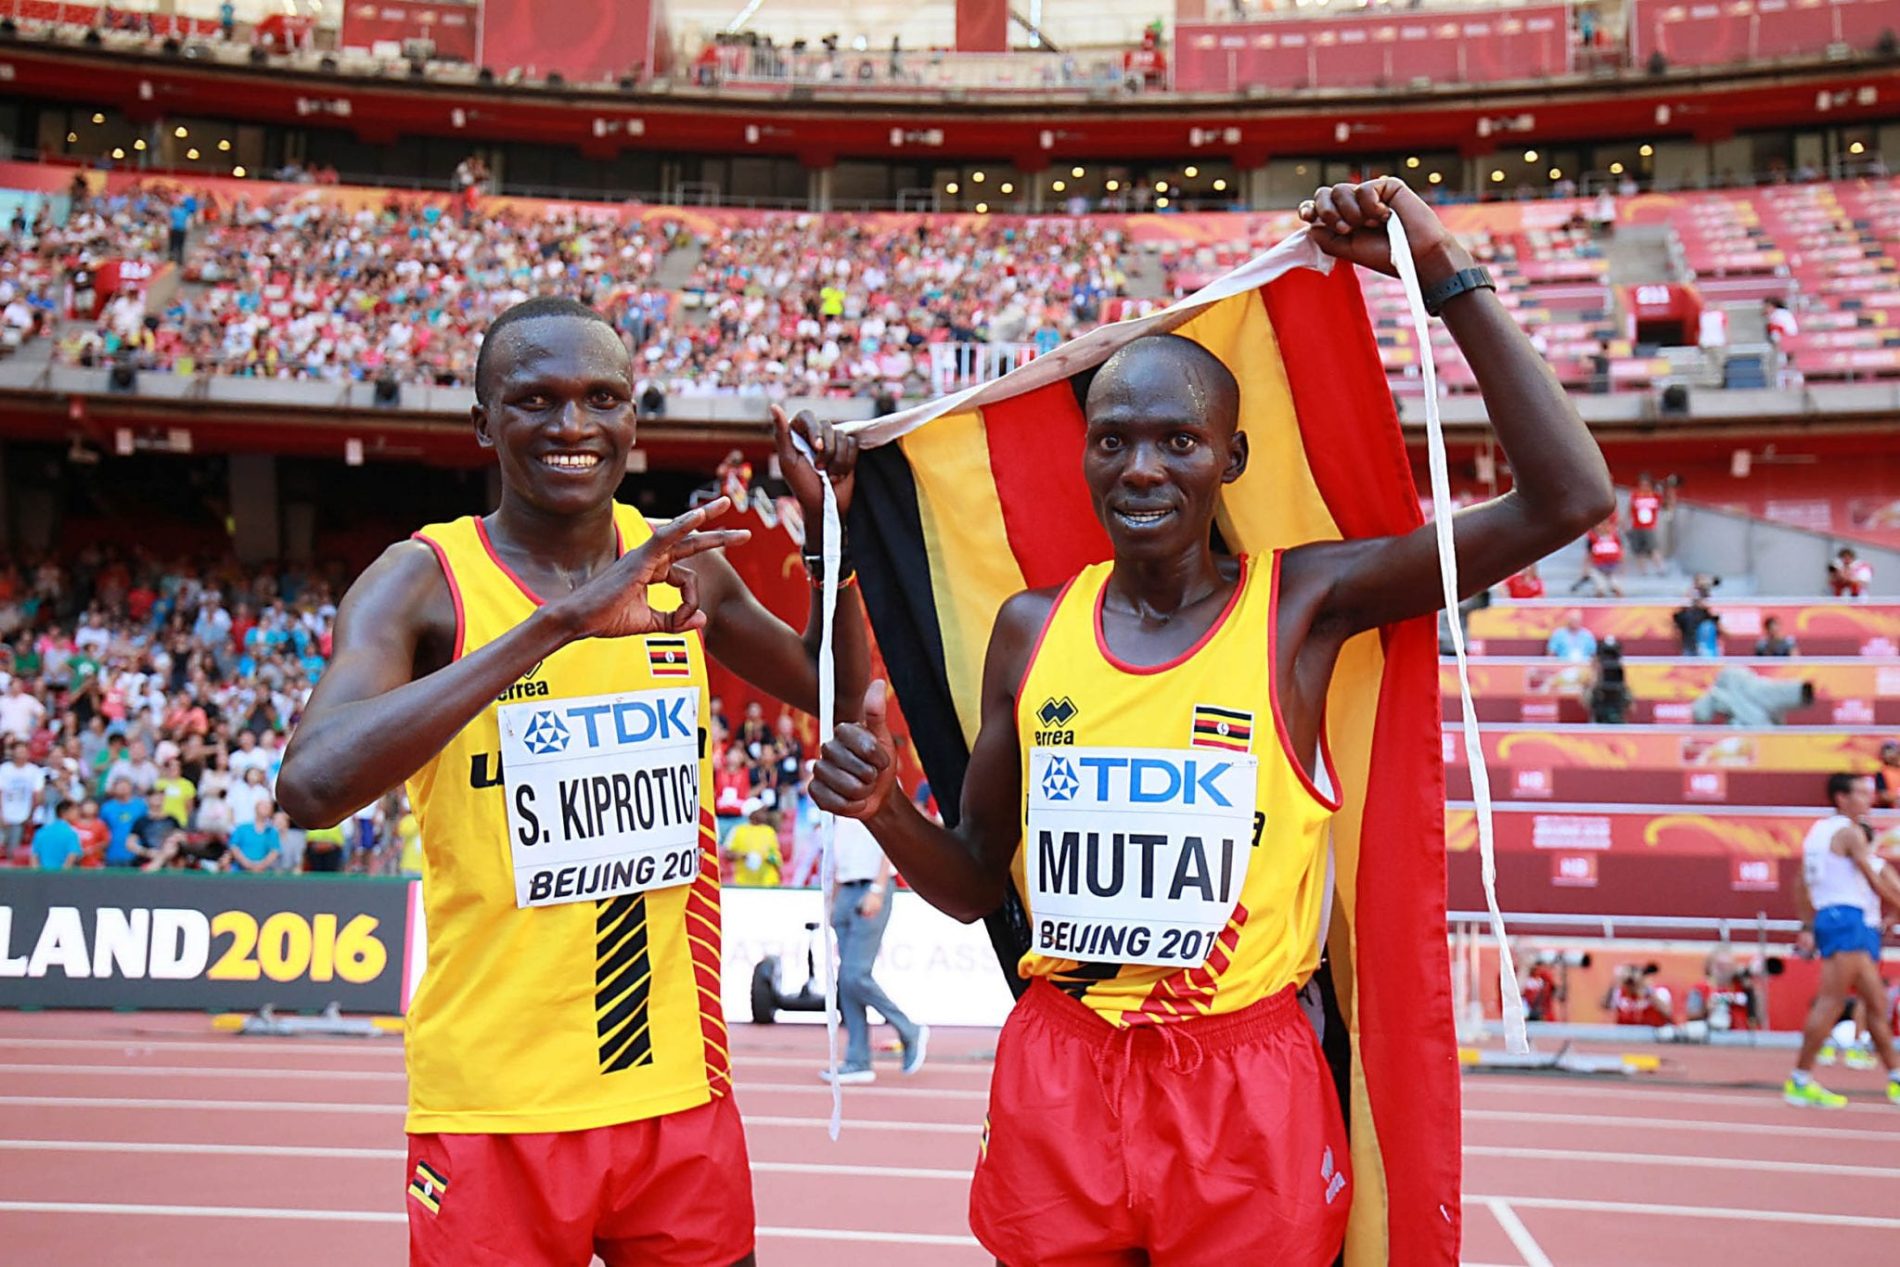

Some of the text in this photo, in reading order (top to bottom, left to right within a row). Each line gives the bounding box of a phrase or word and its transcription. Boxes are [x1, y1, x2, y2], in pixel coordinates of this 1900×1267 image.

[567, 697, 691, 748] TDK
[1035, 730, 1075, 747] errea
[1079, 757, 1234, 808] TDK
[515, 784, 550, 847] S.
[529, 855, 656, 901] BEIJING
[1038, 830, 1234, 903] MUTAI
[1040, 919, 1151, 958] BEIJING
